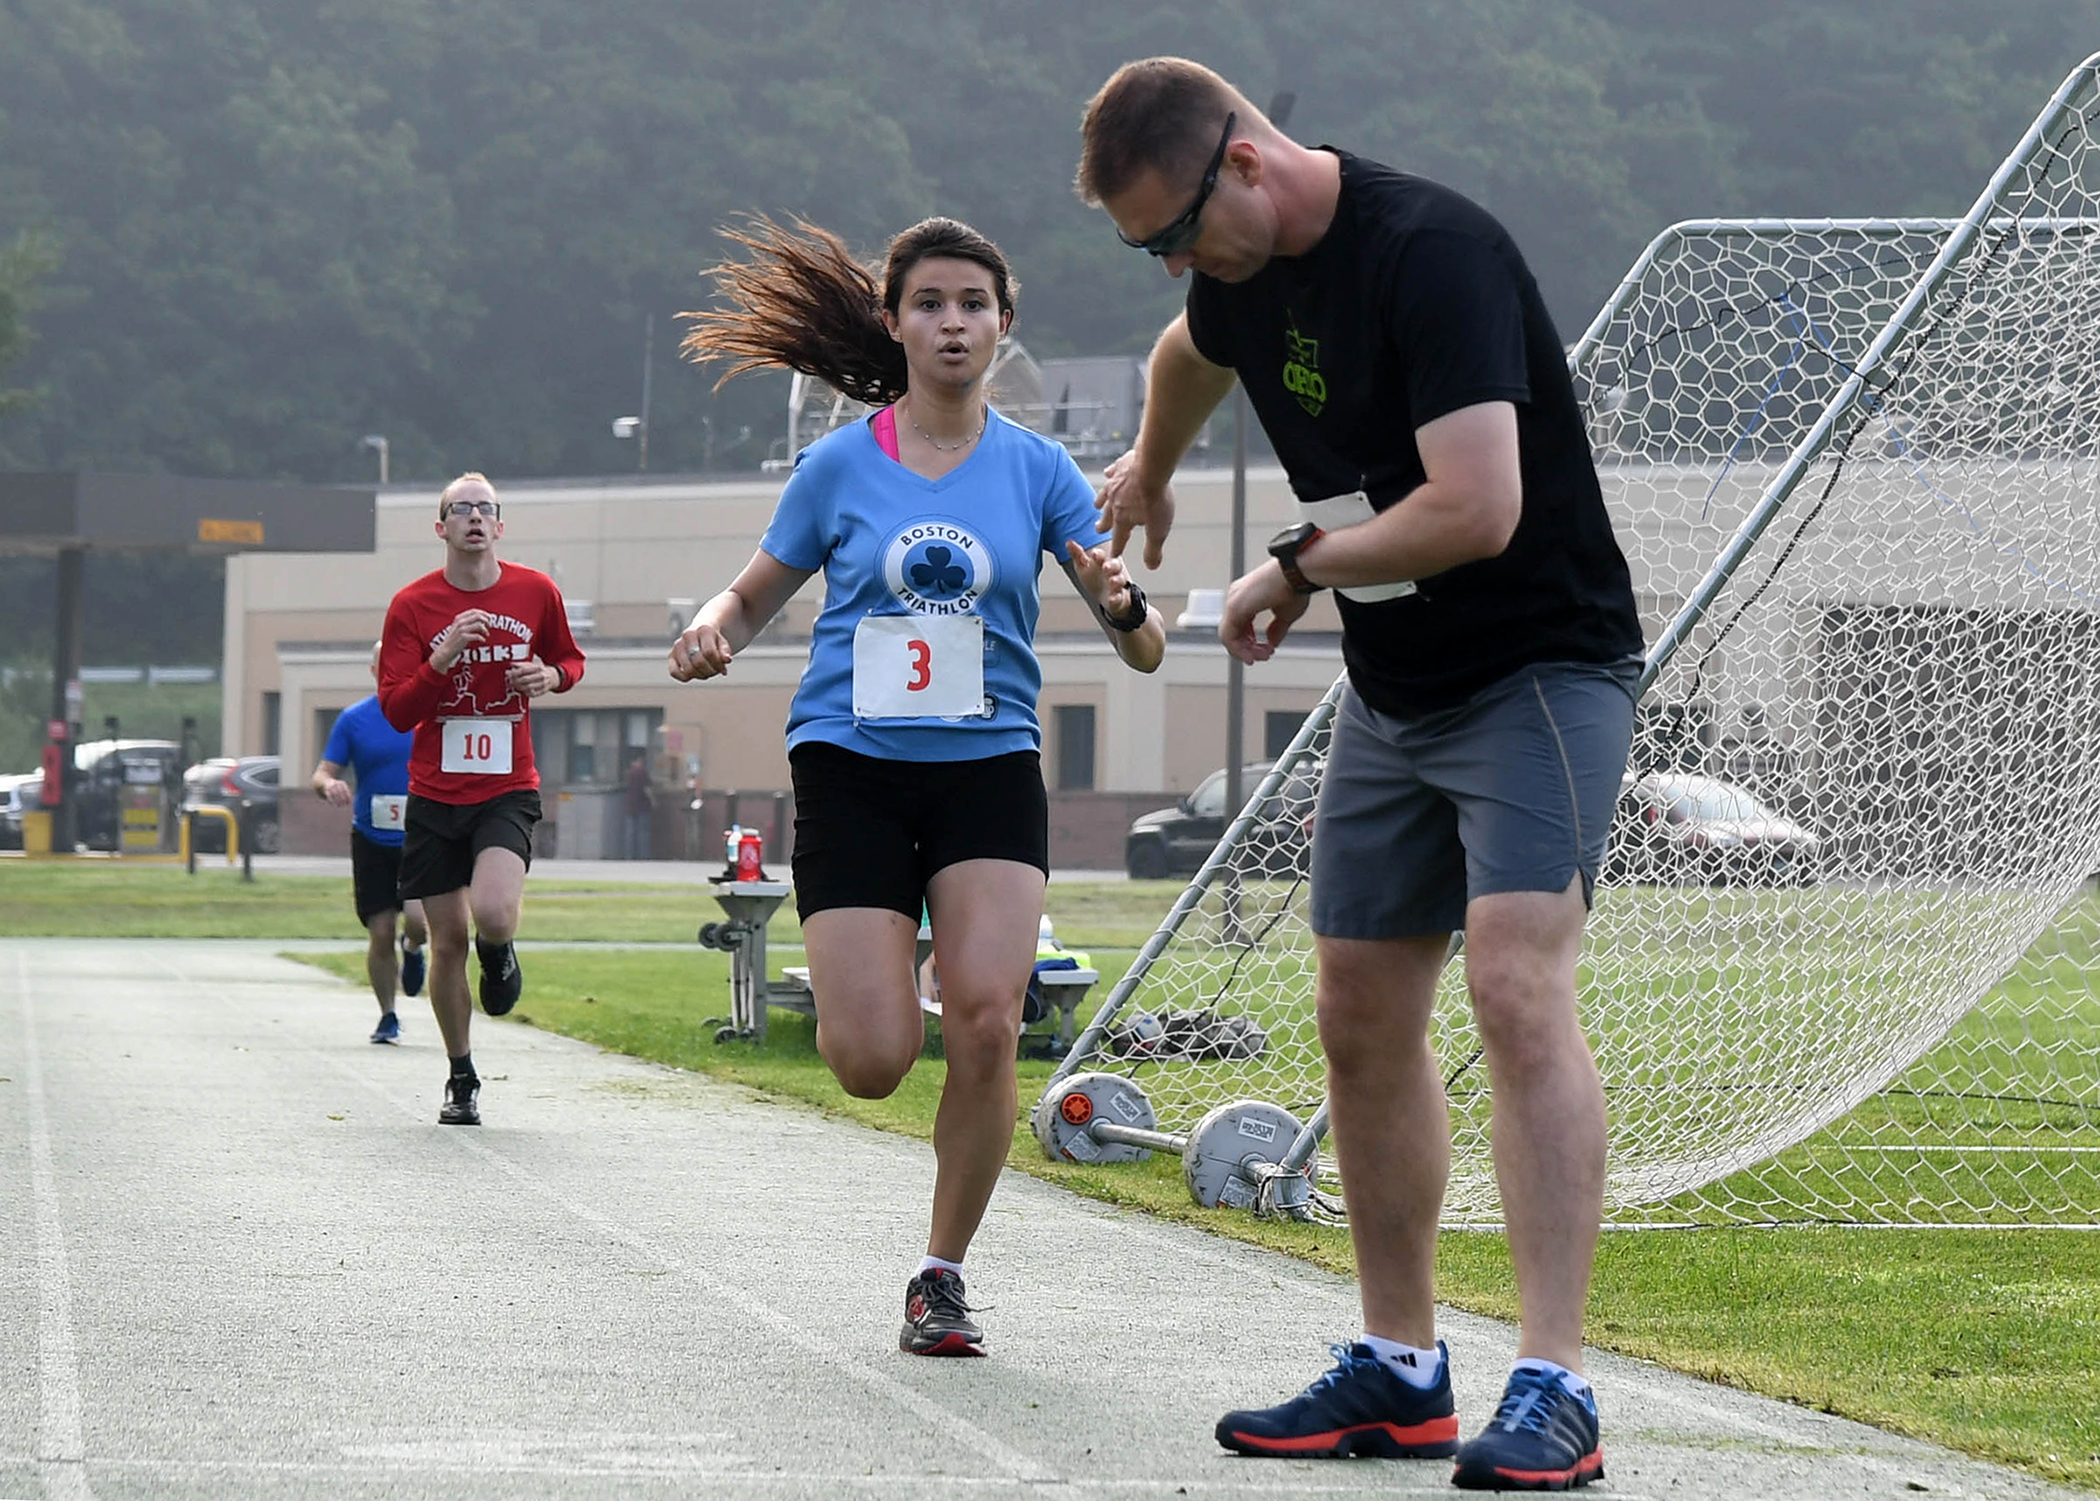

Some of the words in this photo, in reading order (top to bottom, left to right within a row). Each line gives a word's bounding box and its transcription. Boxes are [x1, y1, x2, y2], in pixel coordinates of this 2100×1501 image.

[900, 526, 973, 549] BOSTON
[897, 588, 978, 615] TRIATHLON
[489, 613, 533, 643] RATHON
[906, 639, 931, 692] 3
[463, 733, 491, 761] 10
[390, 804, 399, 821] 5
